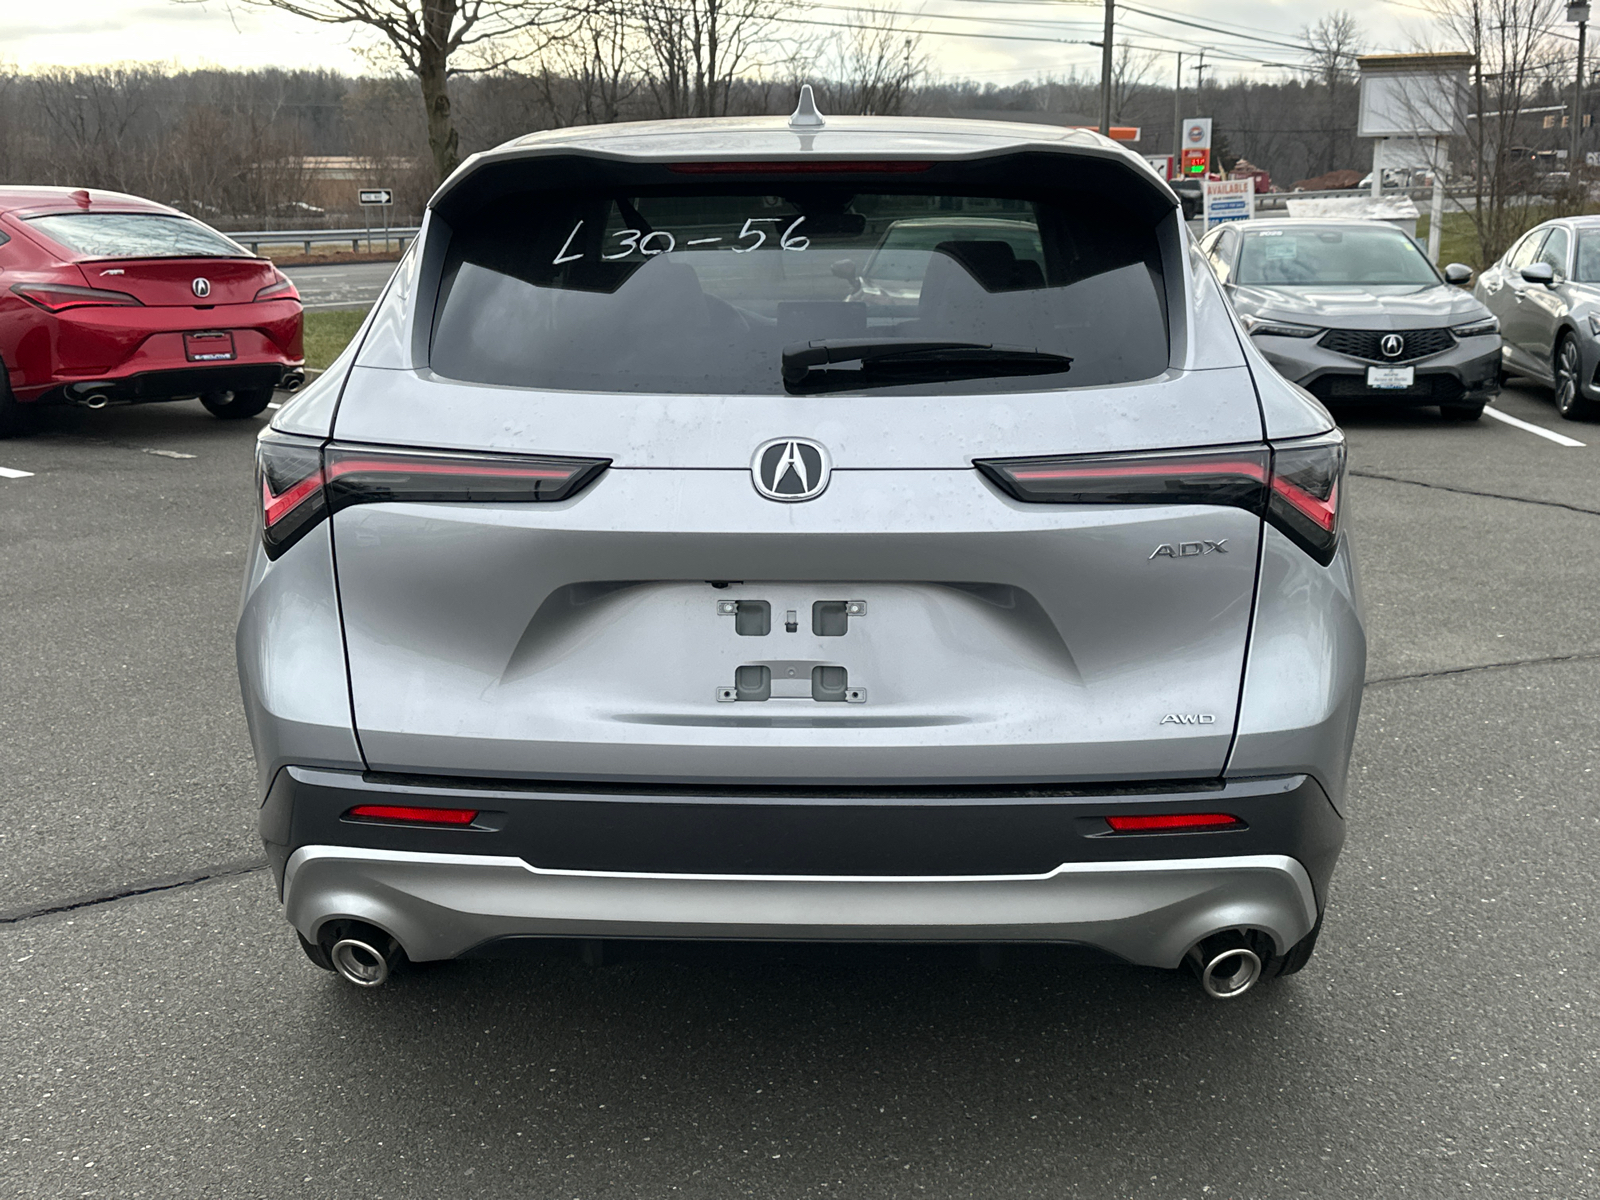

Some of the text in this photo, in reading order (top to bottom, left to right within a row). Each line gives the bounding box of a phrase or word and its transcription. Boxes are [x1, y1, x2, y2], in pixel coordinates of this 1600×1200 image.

[1207, 182, 1248, 195] AVAILABLE
[1148, 539, 1228, 560] ADX
[1160, 713, 1216, 725] AWD
